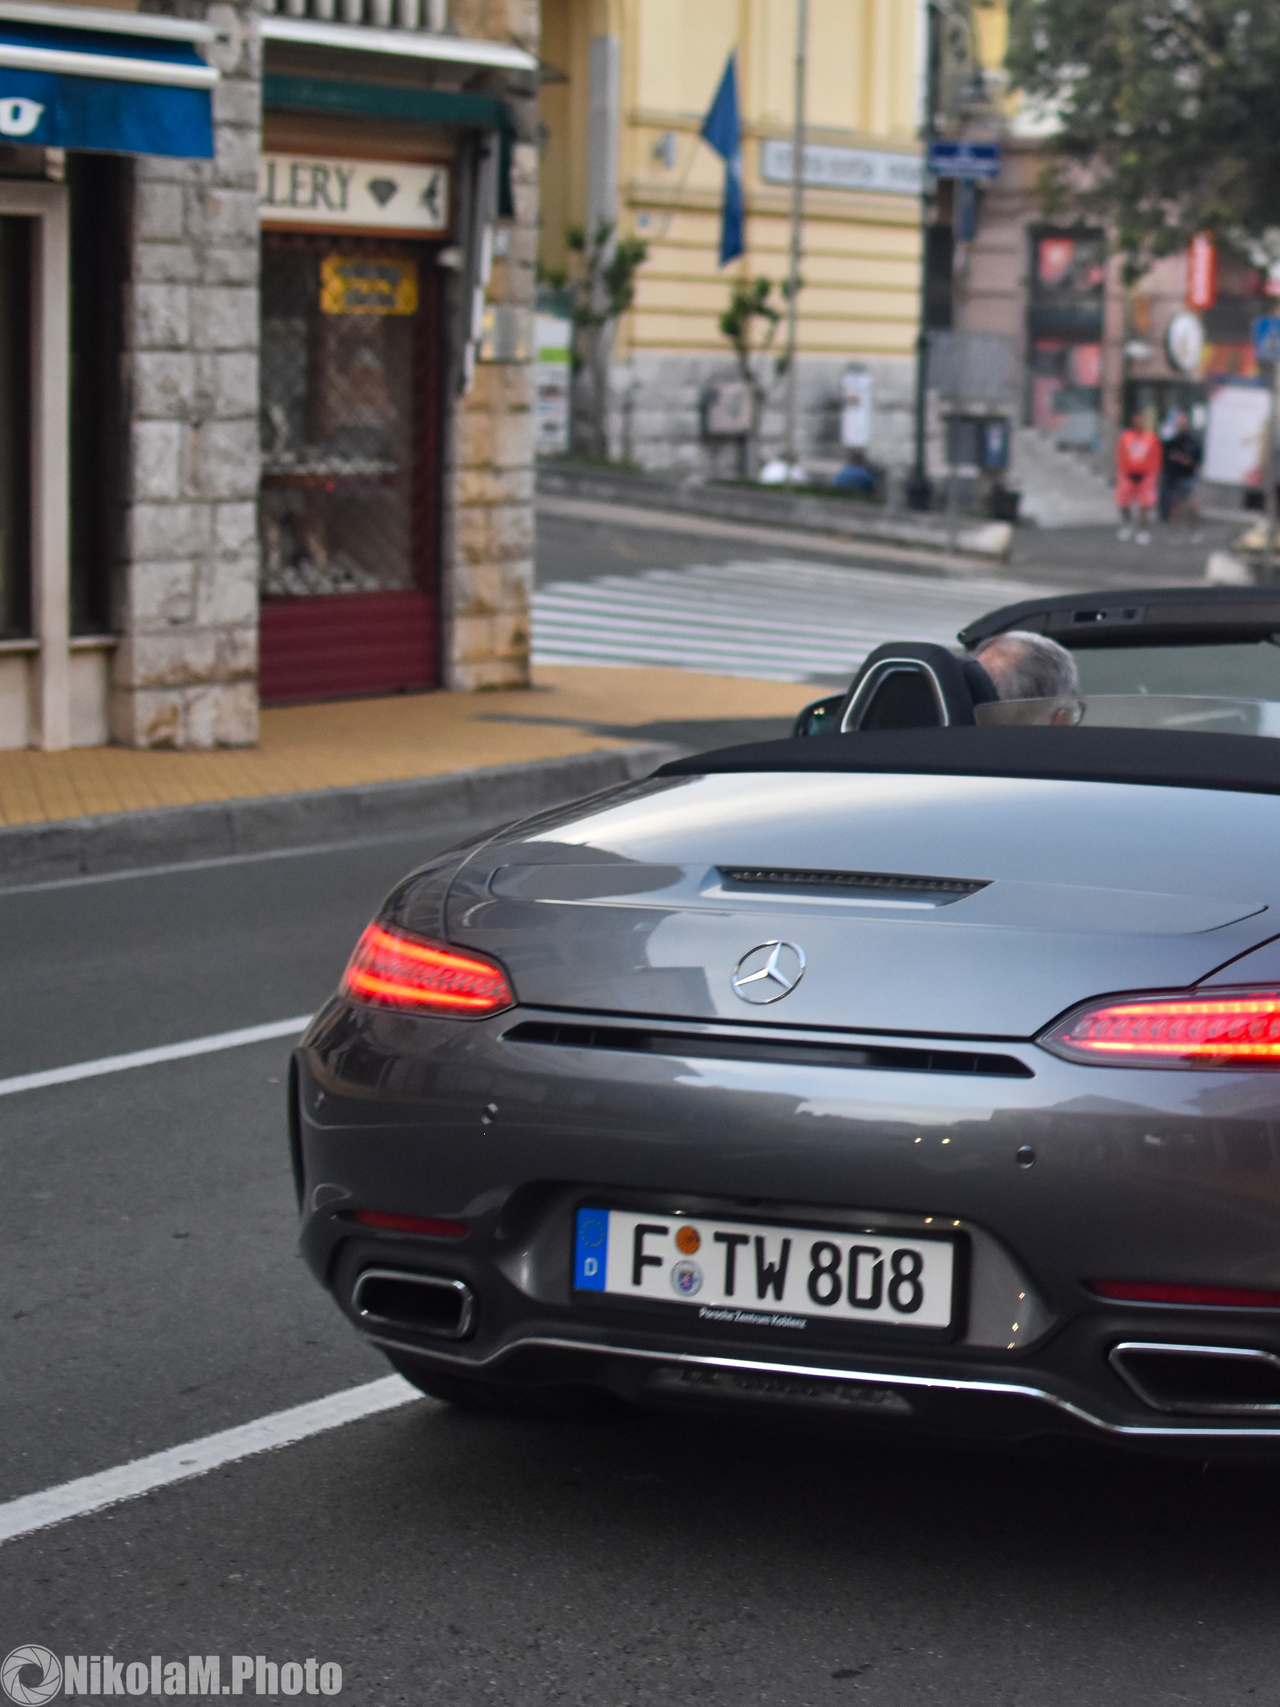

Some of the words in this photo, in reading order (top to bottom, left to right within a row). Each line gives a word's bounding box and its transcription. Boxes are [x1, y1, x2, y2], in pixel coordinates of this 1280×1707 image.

[584, 1257, 598, 1276] D
[632, 1223, 669, 1286] F
[713, 1231, 792, 1301] TW
[807, 1240, 924, 1314] 808
